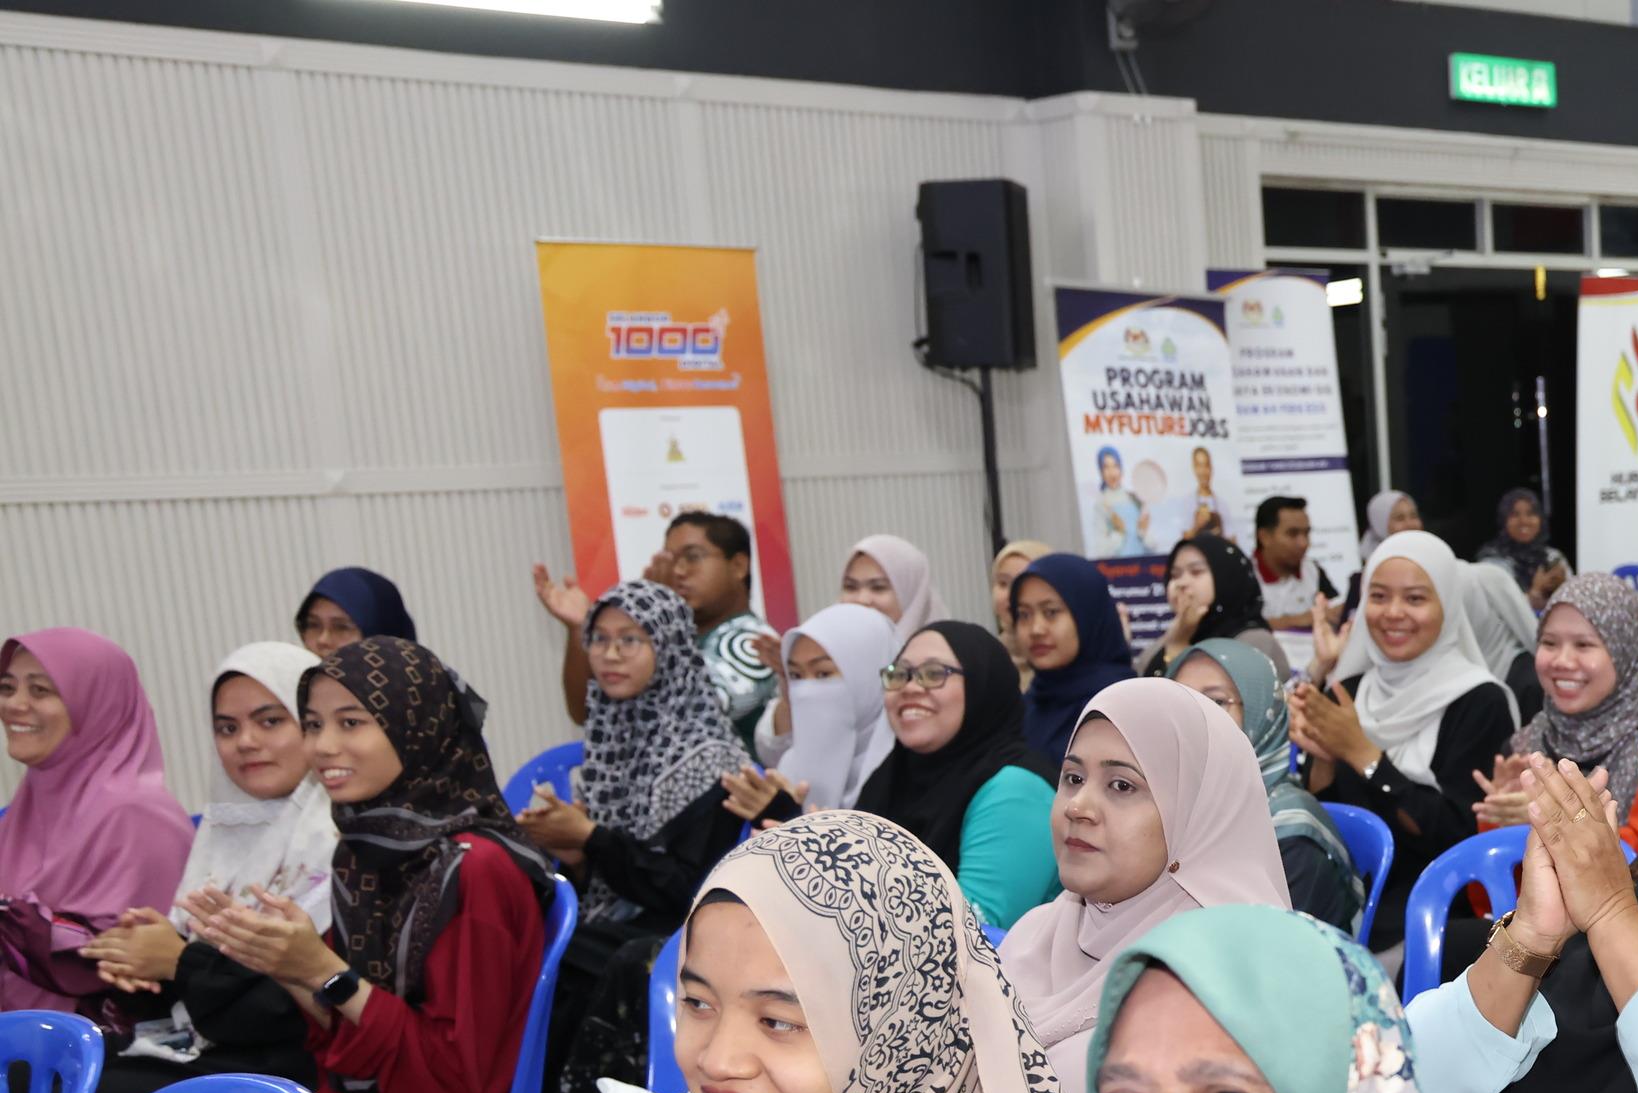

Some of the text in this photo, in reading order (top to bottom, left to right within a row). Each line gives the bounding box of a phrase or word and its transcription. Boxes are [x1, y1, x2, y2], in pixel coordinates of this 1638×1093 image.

[610, 326, 719, 355] 1000
[1105, 367, 1206, 391] PROGRAM
[1093, 390, 1212, 414] USAHAWAN
[1084, 413, 1229, 439] MYFUTUREJOBS
